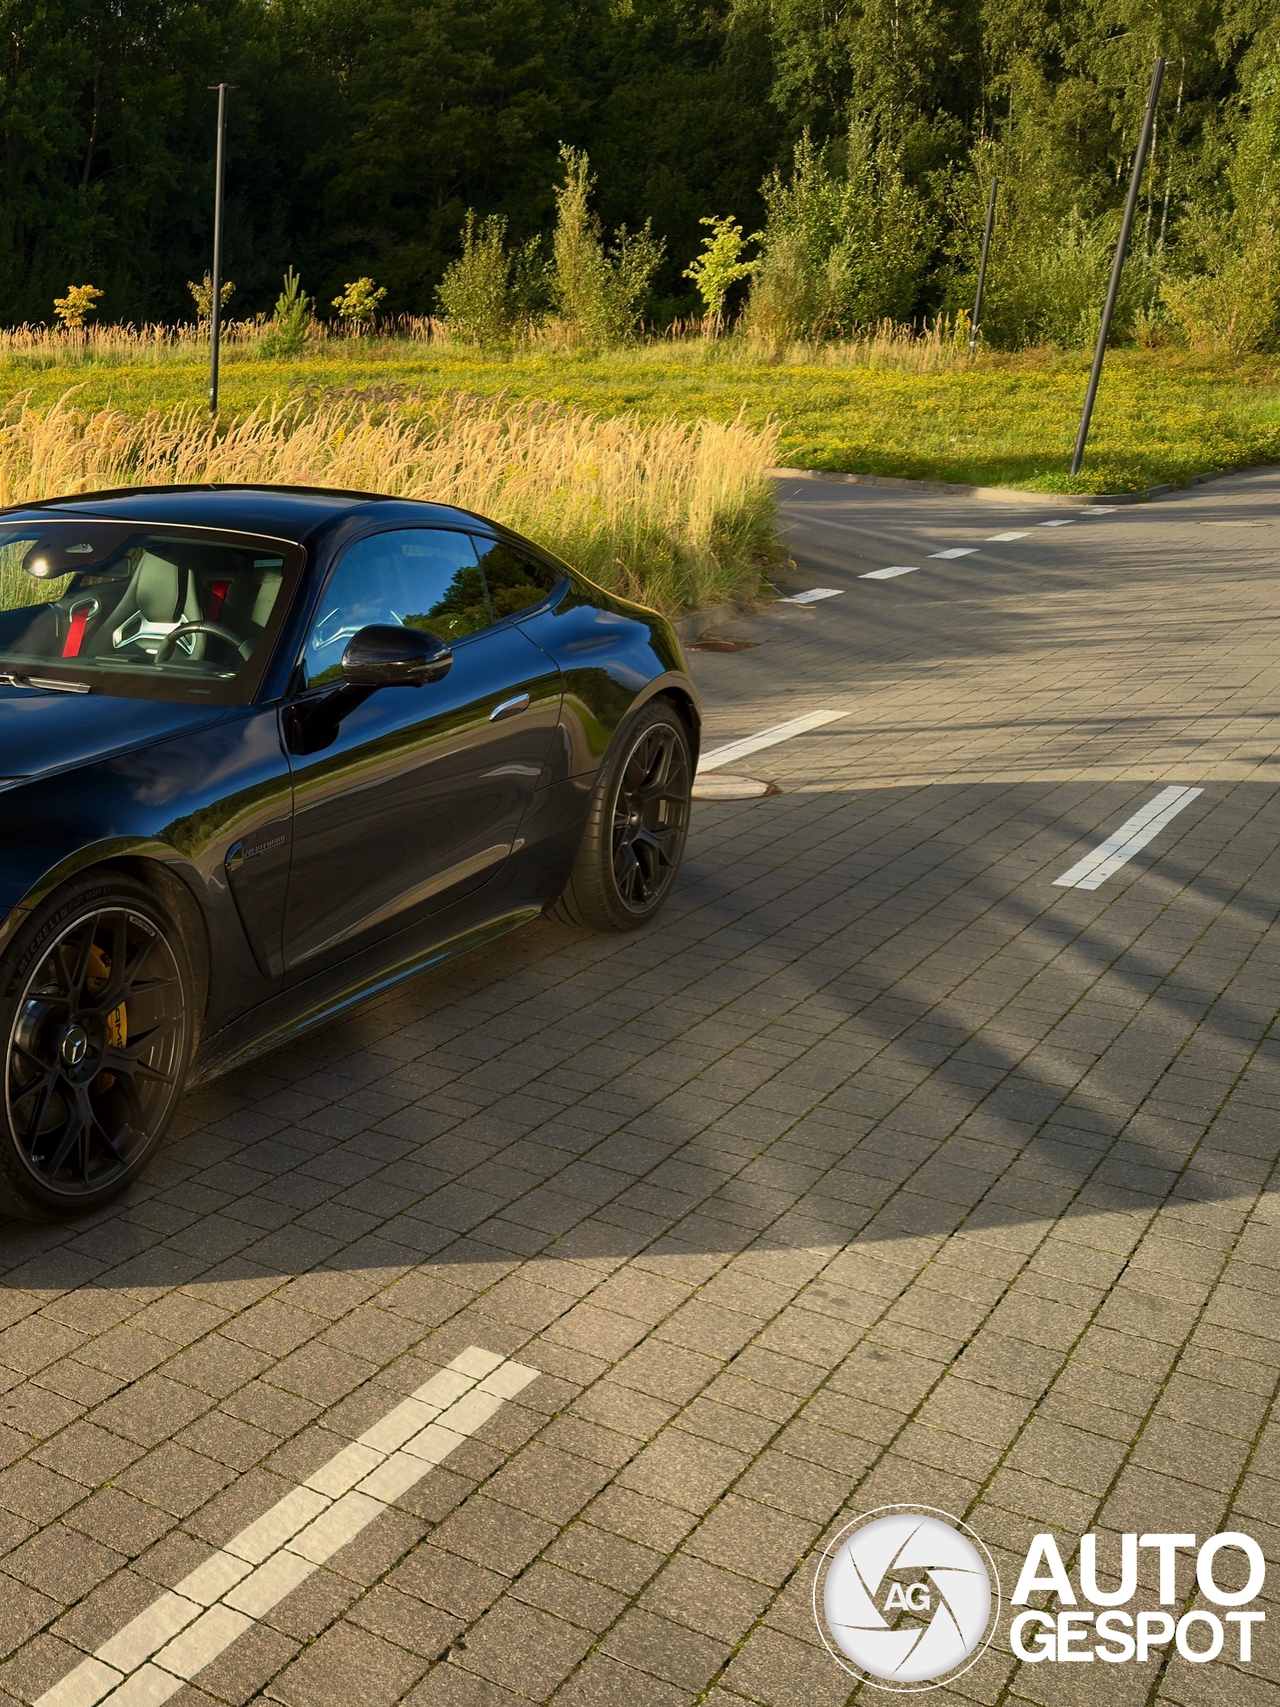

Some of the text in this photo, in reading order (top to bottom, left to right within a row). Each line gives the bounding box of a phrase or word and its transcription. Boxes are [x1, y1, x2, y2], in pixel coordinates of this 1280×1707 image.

[18, 906, 68, 975] MICHELIN
[69, 895, 84, 910] PILOT
[85, 888, 102, 900] SPORT
